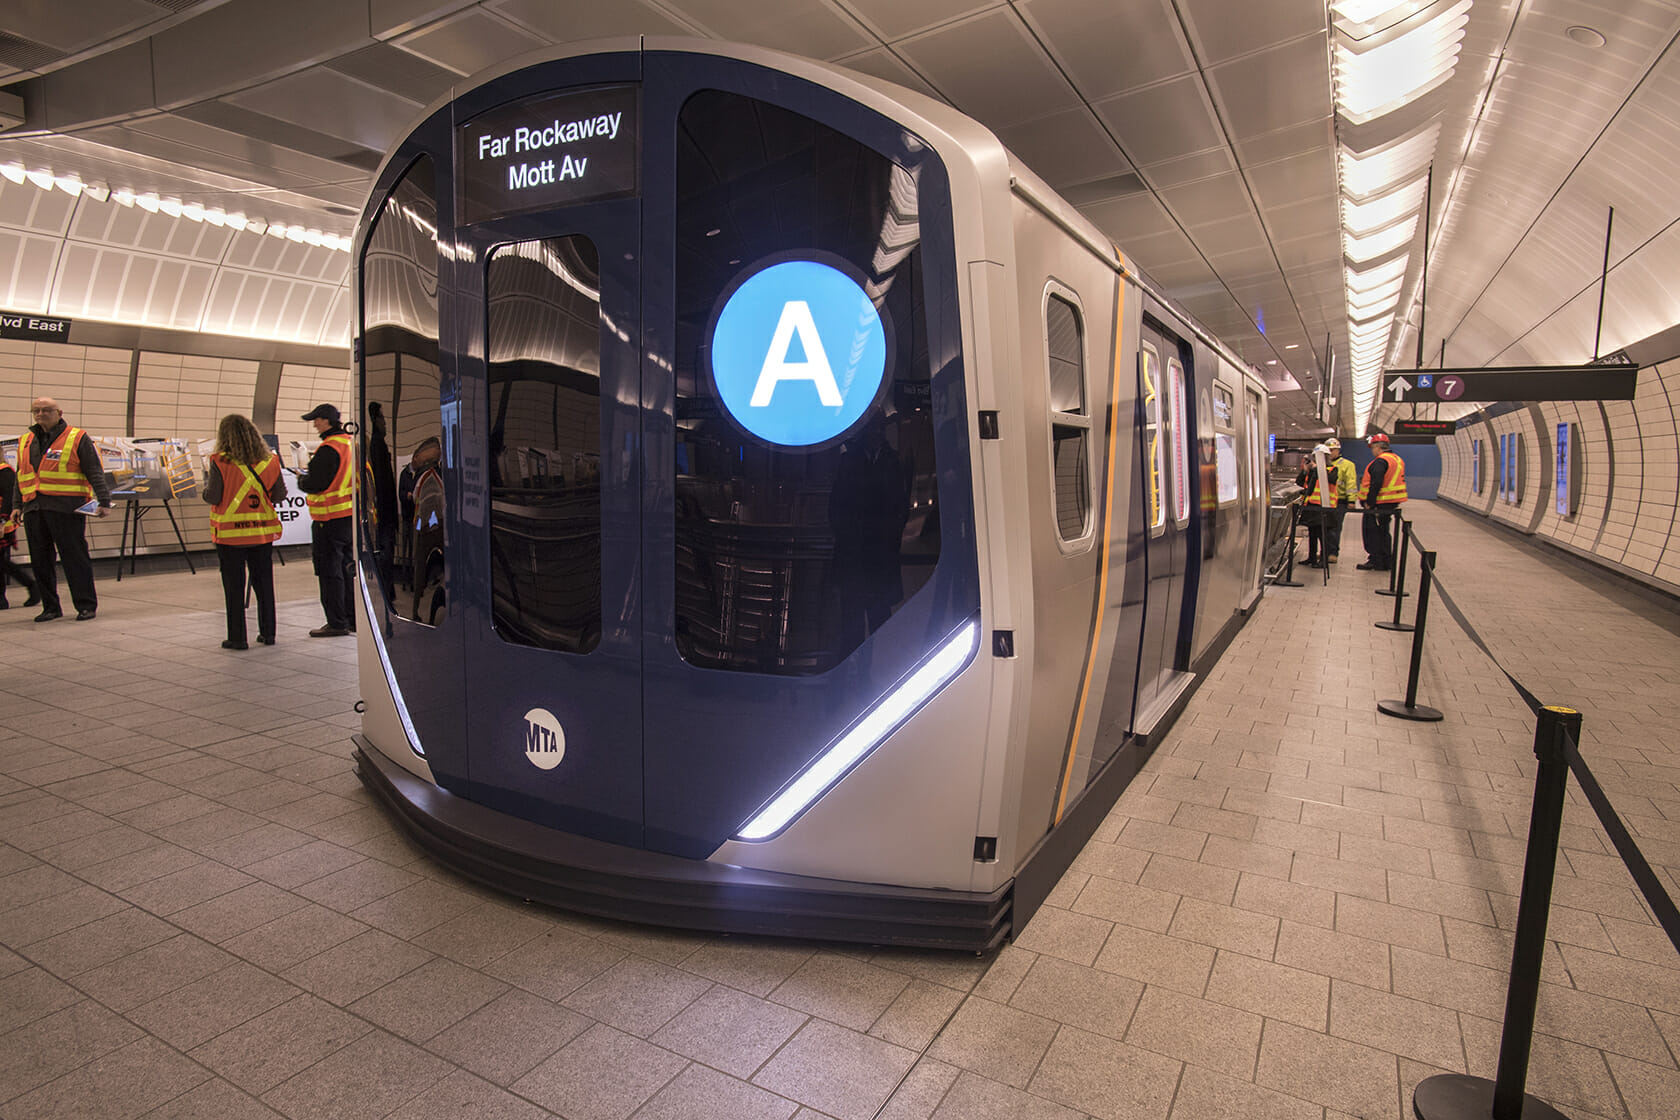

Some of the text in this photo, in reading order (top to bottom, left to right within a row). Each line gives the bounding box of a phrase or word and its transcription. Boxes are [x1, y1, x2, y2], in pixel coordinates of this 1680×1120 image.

[479, 112, 622, 160] Far Rockaway
[509, 154, 587, 190] Mott Av
[28, 319, 64, 332] East
[750, 301, 844, 407] A
[1444, 380, 1457, 396] 7
[285, 496, 307, 508] YO
[277, 510, 300, 521] EP
[523, 719, 558, 752] MTA
